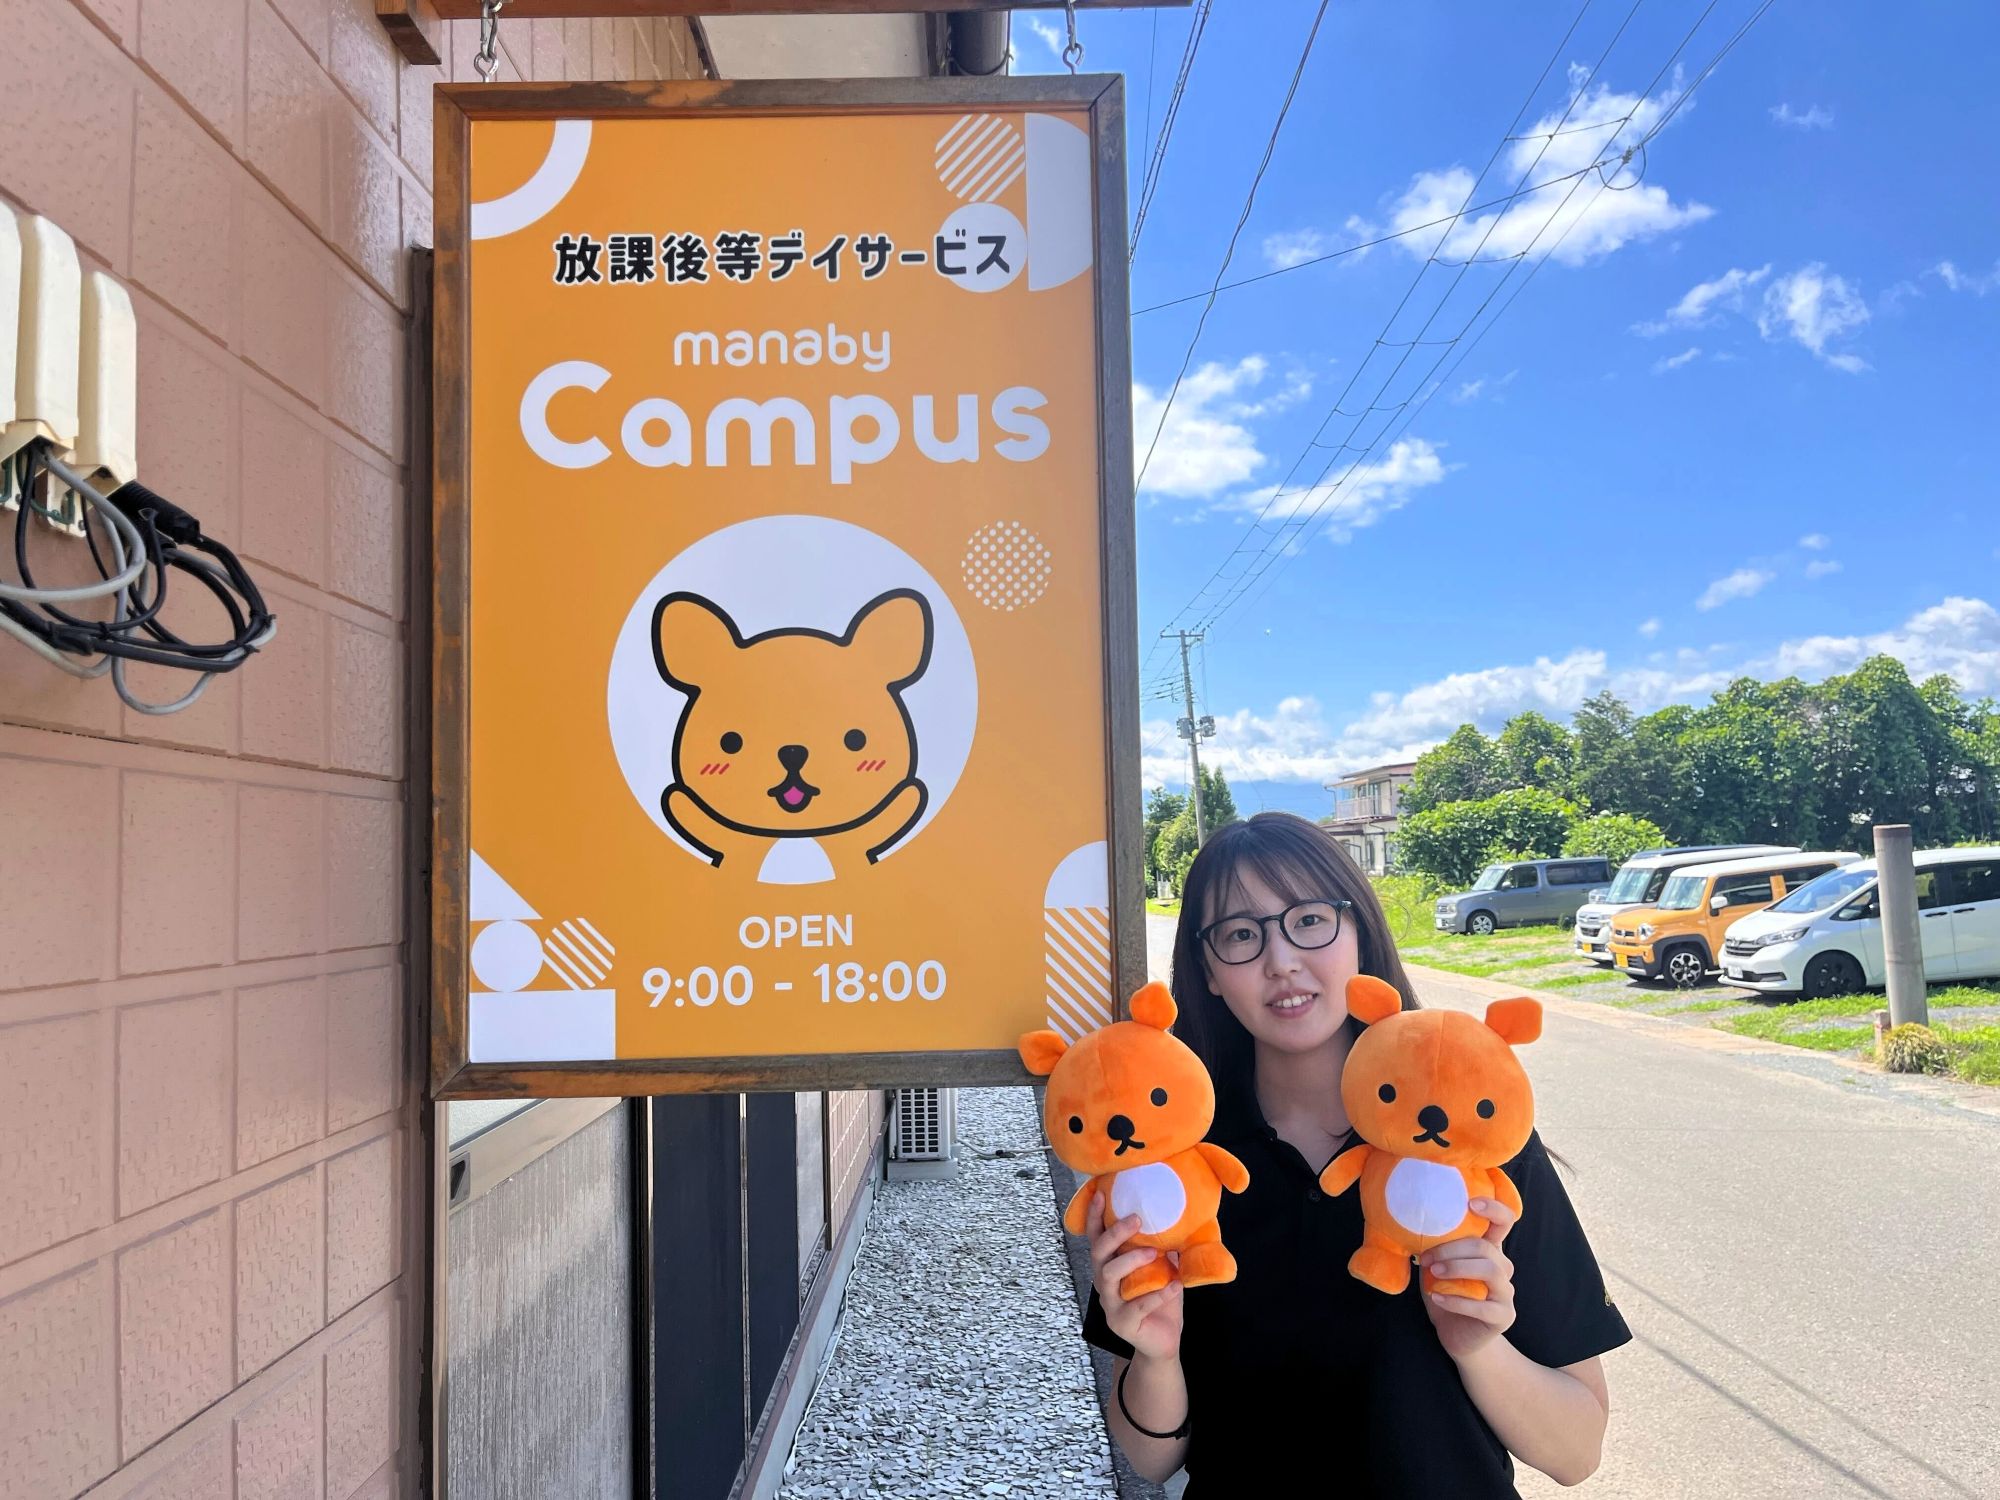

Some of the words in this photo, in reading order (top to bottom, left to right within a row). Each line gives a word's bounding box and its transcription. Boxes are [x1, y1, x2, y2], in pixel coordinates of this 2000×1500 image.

[553, 229, 1012, 285] 放課後等デイサービス
[672, 323, 892, 373] manaby
[519, 360, 1051, 485] Campus
[738, 913, 853, 949] OPEN
[642, 965, 753, 1008] 9:00
[774, 982, 793, 990] -
[812, 959, 948, 1003] 18:00
